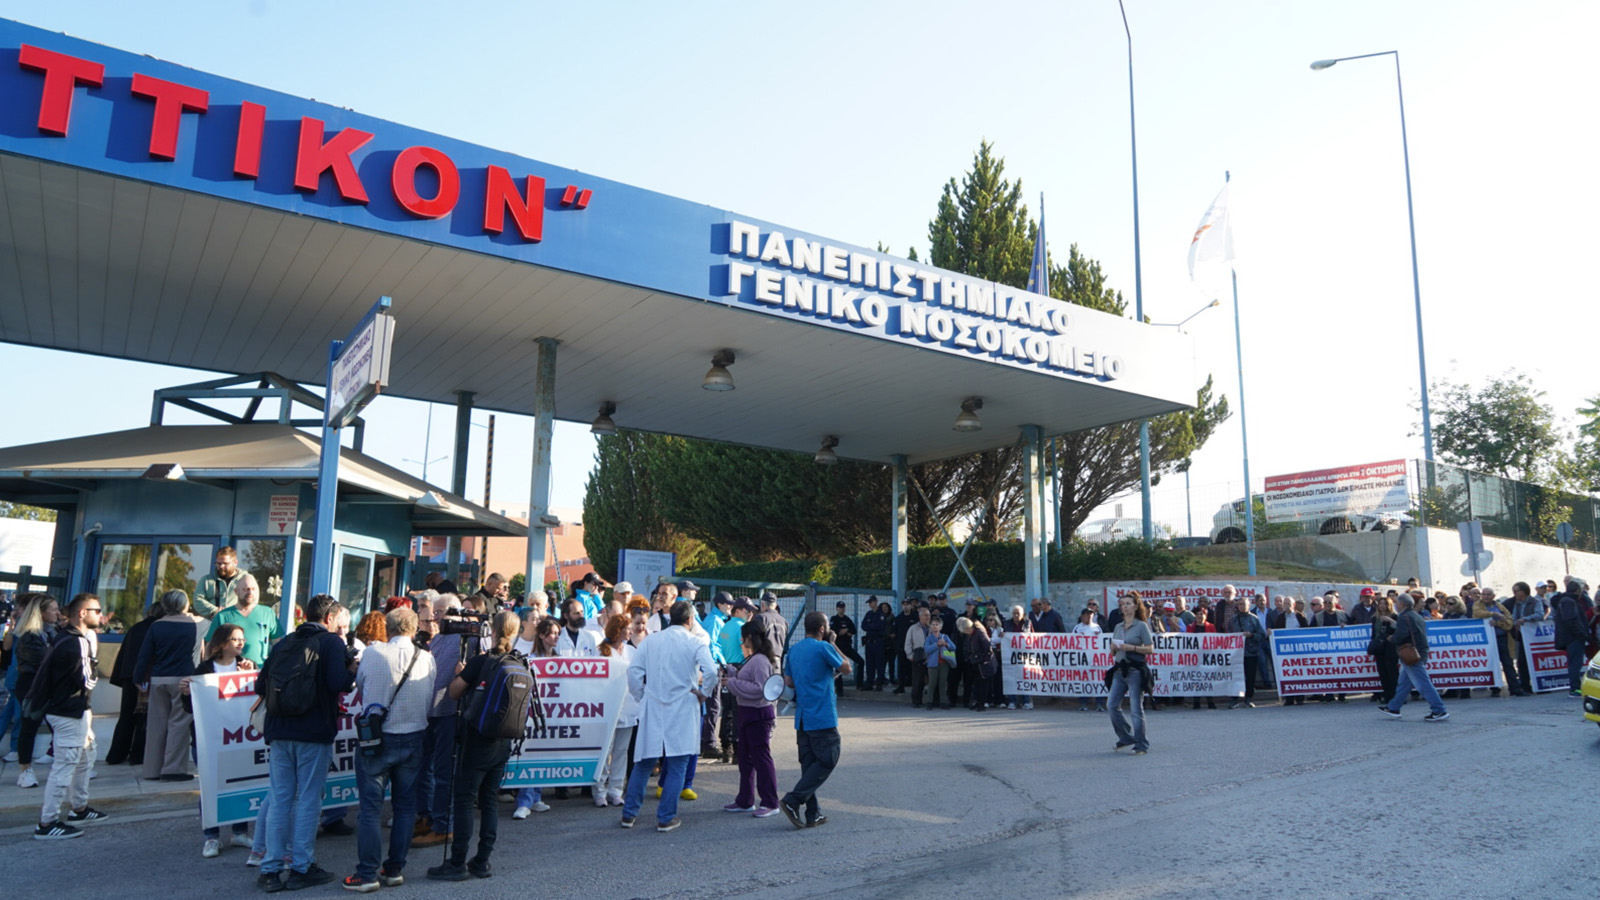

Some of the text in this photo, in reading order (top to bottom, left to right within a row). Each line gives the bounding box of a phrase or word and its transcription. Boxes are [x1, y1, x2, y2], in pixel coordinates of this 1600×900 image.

[729, 220, 1075, 335] ΠΑΝΕΠΙΣΤΗΜΙΑΚΟ
[728, 263, 1125, 380] ΓΕΝΙΚΟ ΝΟΣΟΚΟΜΕΙΟ
[1011, 635, 1099, 650] ΑΓΩΝΙΖΟΜΑΣΤΕ
[1202, 635, 1244, 650] ΔΗΜΟΣΙΑ
[1279, 643, 1294, 652] ΚΑΙ
[1295, 639, 1371, 652] ΙΑΤΡΟΦΑΡΜΑΚΕΥΤ
[1439, 635, 1453, 644] ΓΙΑ
[1455, 632, 1484, 643] ΟΛΟΥΣ
[1330, 630, 1367, 640] ΔΗΜΟΣΙΑ
[1010, 651, 1049, 666] ΔΩΡΕΑΝ
[1053, 651, 1088, 666] ΥΓΕΙΑ
[1177, 653, 1198, 666] ΑΠΟ
[1202, 653, 1231, 666] ΚΑΘΕ
[1281, 656, 1333, 667] ΑΜΕΣΕΣ
[1429, 648, 1487, 660] ΓΙΑΤΡΩΝ
[1537, 655, 1568, 669] ΜΕΤΡ
[545, 660, 606, 675] ΟΛΟΥΣ
[1282, 659, 1488, 677] ΚΑΙ ΝΟΣΗΛΕΥΤΙ ΟΣΩΠΙΚΟΥ
[1041, 682, 1109, 694] ΣΥΝΤΑΞΙΟΥΧ
[1182, 682, 1213, 692] ΒΑΡΒΑΡΑ
[1284, 681, 1338, 691] ΣΥΝΔΕΣΜΟΣ
[1431, 675, 1491, 684] ΠΕΡΙΣΤΕΡΙΟΥ
[518, 766, 584, 780] ΑΤΤΙΚΟΝ
